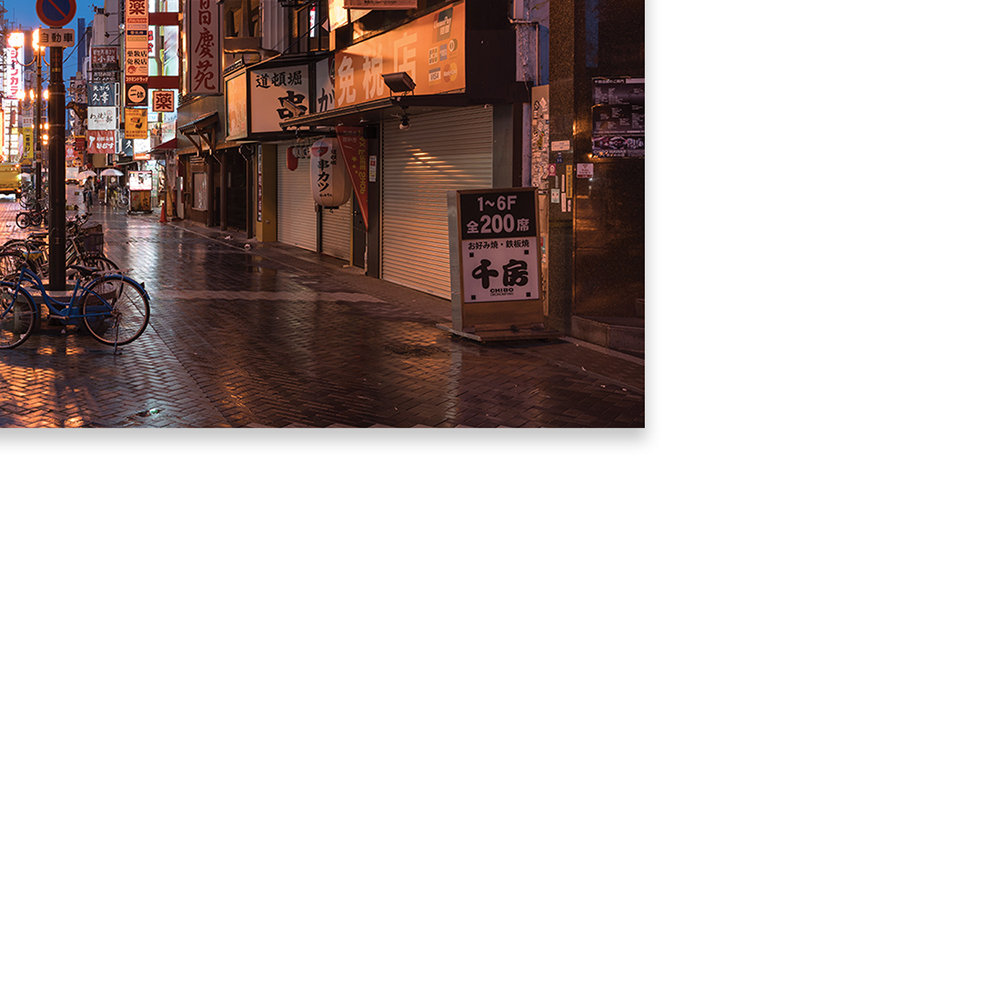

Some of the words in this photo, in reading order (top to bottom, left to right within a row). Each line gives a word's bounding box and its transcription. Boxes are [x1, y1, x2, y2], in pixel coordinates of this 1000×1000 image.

[41, 32, 74, 44] 自動車
[255, 70, 302, 89] 道頓堀
[155, 93, 172, 109] 薬
[317, 159, 330, 193] 串カツ
[466, 214, 530, 234] 全200席
[472, 259, 529, 290] 千房
